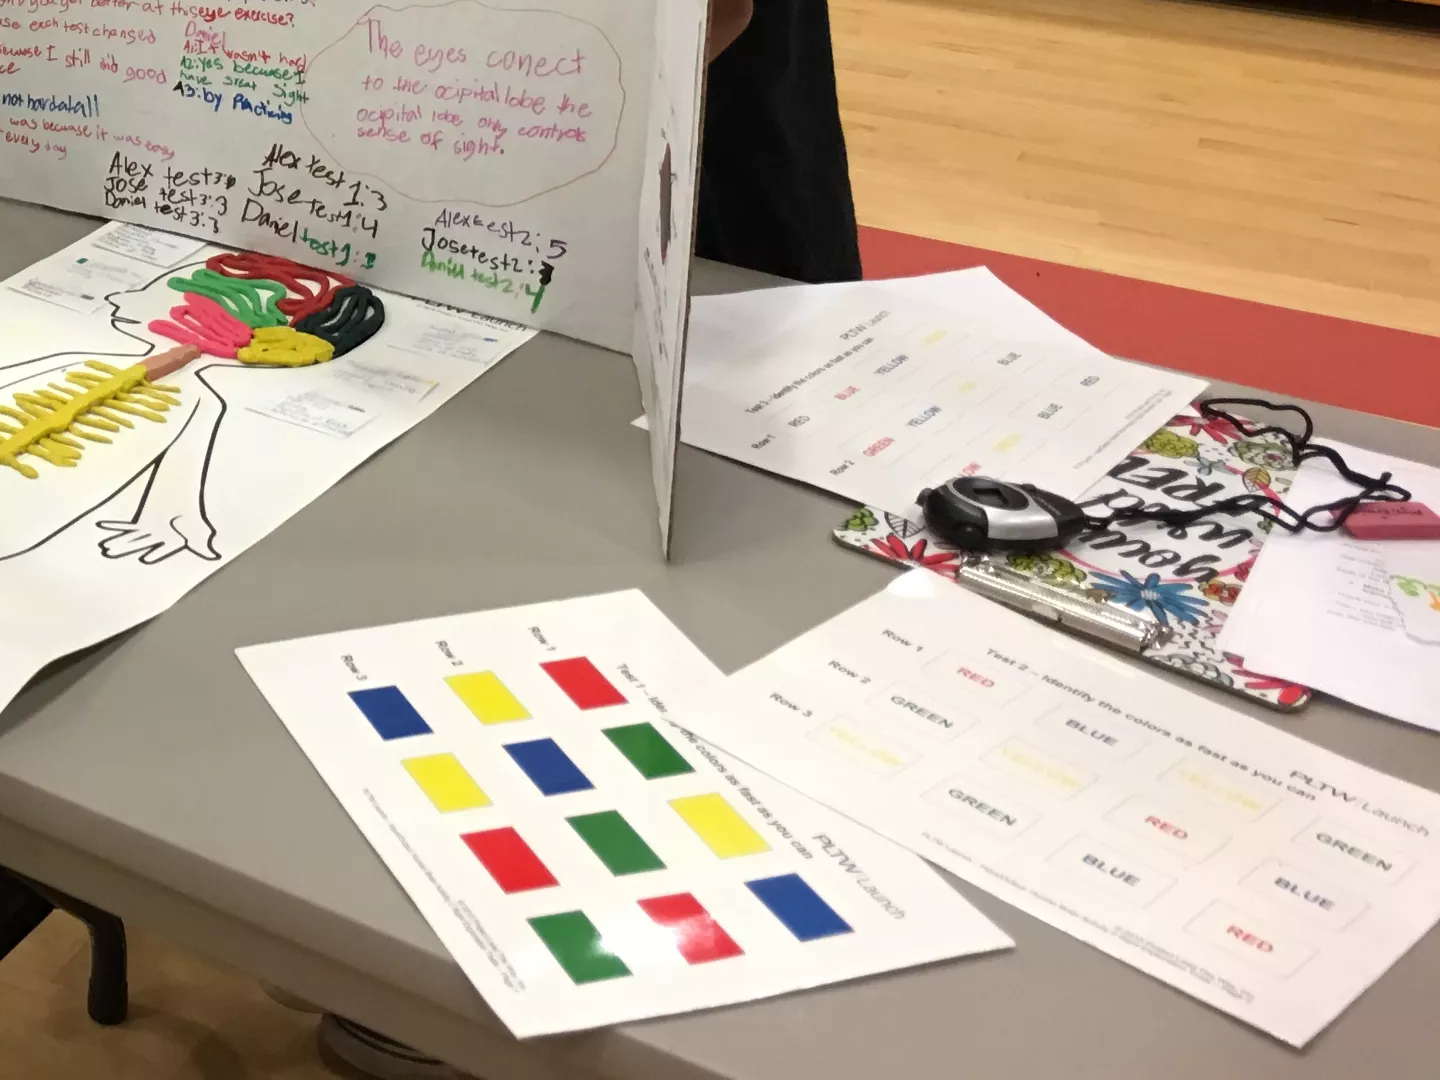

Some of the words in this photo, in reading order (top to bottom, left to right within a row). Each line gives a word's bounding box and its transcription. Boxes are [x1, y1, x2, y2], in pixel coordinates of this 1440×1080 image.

[142, 0, 164, 15] at
[198, 6, 231, 23] eye
[63, 21, 89, 37] test
[279, 51, 306, 71] hard
[357, 17, 403, 58] The
[414, 44, 467, 73] eyes
[486, 49, 585, 78] conect
[47, 44, 58, 61] I
[66, 48, 90, 67] still
[123, 66, 167, 84] good
[180, 69, 212, 86] have
[294, 70, 306, 84] I
[2, 93, 24, 107] not
[203, 87, 222, 112] by
[362, 74, 384, 91] to
[393, 77, 427, 95] the
[507, 85, 545, 115] lobe
[557, 93, 592, 118] the
[10, 118, 38, 129] was
[113, 133, 142, 146] was
[356, 125, 411, 144] sense
[420, 130, 443, 150] of
[432, 109, 463, 127] lobe
[478, 117, 507, 138] only
[6, 131, 40, 153] every
[45, 140, 67, 161] day
[109, 151, 154, 178] Alex
[262, 143, 301, 169] Alex
[371, 189, 387, 211] 3
[104, 176, 148, 194] Jose
[248, 168, 303, 204] Jose
[362, 217, 378, 239] 4
[241, 198, 298, 242] Daniel
[435, 208, 470, 228] Alex
[546, 239, 568, 259] 5
[436, 640, 457, 660] Row
[528, 626, 550, 647] Row
[341, 654, 362, 674] Row
[985, 647, 1017, 667] Test
[1041, 673, 1096, 702] Identify
[1097, 697, 1122, 715] the
[1125, 713, 1172, 739] colors
[1175, 736, 1194, 748] as
[1197, 744, 1228, 762] fast
[1229, 760, 1249, 772] as
[1251, 768, 1283, 787] you
[1286, 784, 1316, 802] can
[617, 663, 638, 684] Test
[696, 743, 727, 774] colors
[737, 786, 761, 807] fast
[771, 819, 793, 840] you
[790, 840, 813, 859] can
[881, 628, 912, 648] Row
[956, 666, 996, 689] RED
[1065, 718, 1119, 747] BLUE
[1316, 831, 1394, 872] GREEN
[828, 659, 859, 679] Row
[890, 695, 955, 729] GREEN
[1144, 815, 1189, 841] RED
[1274, 876, 1336, 912] BLUE
[1288, 770, 1358, 803] PLTW
[1361, 800, 1430, 837] Launch
[769, 691, 801, 711] Row
[948, 787, 1017, 828] GREEN
[1081, 853, 1142, 887] BLUE
[1226, 924, 1275, 954] RED
[812, 831, 861, 874] PLTW
[856, 873, 906, 920] Launch
